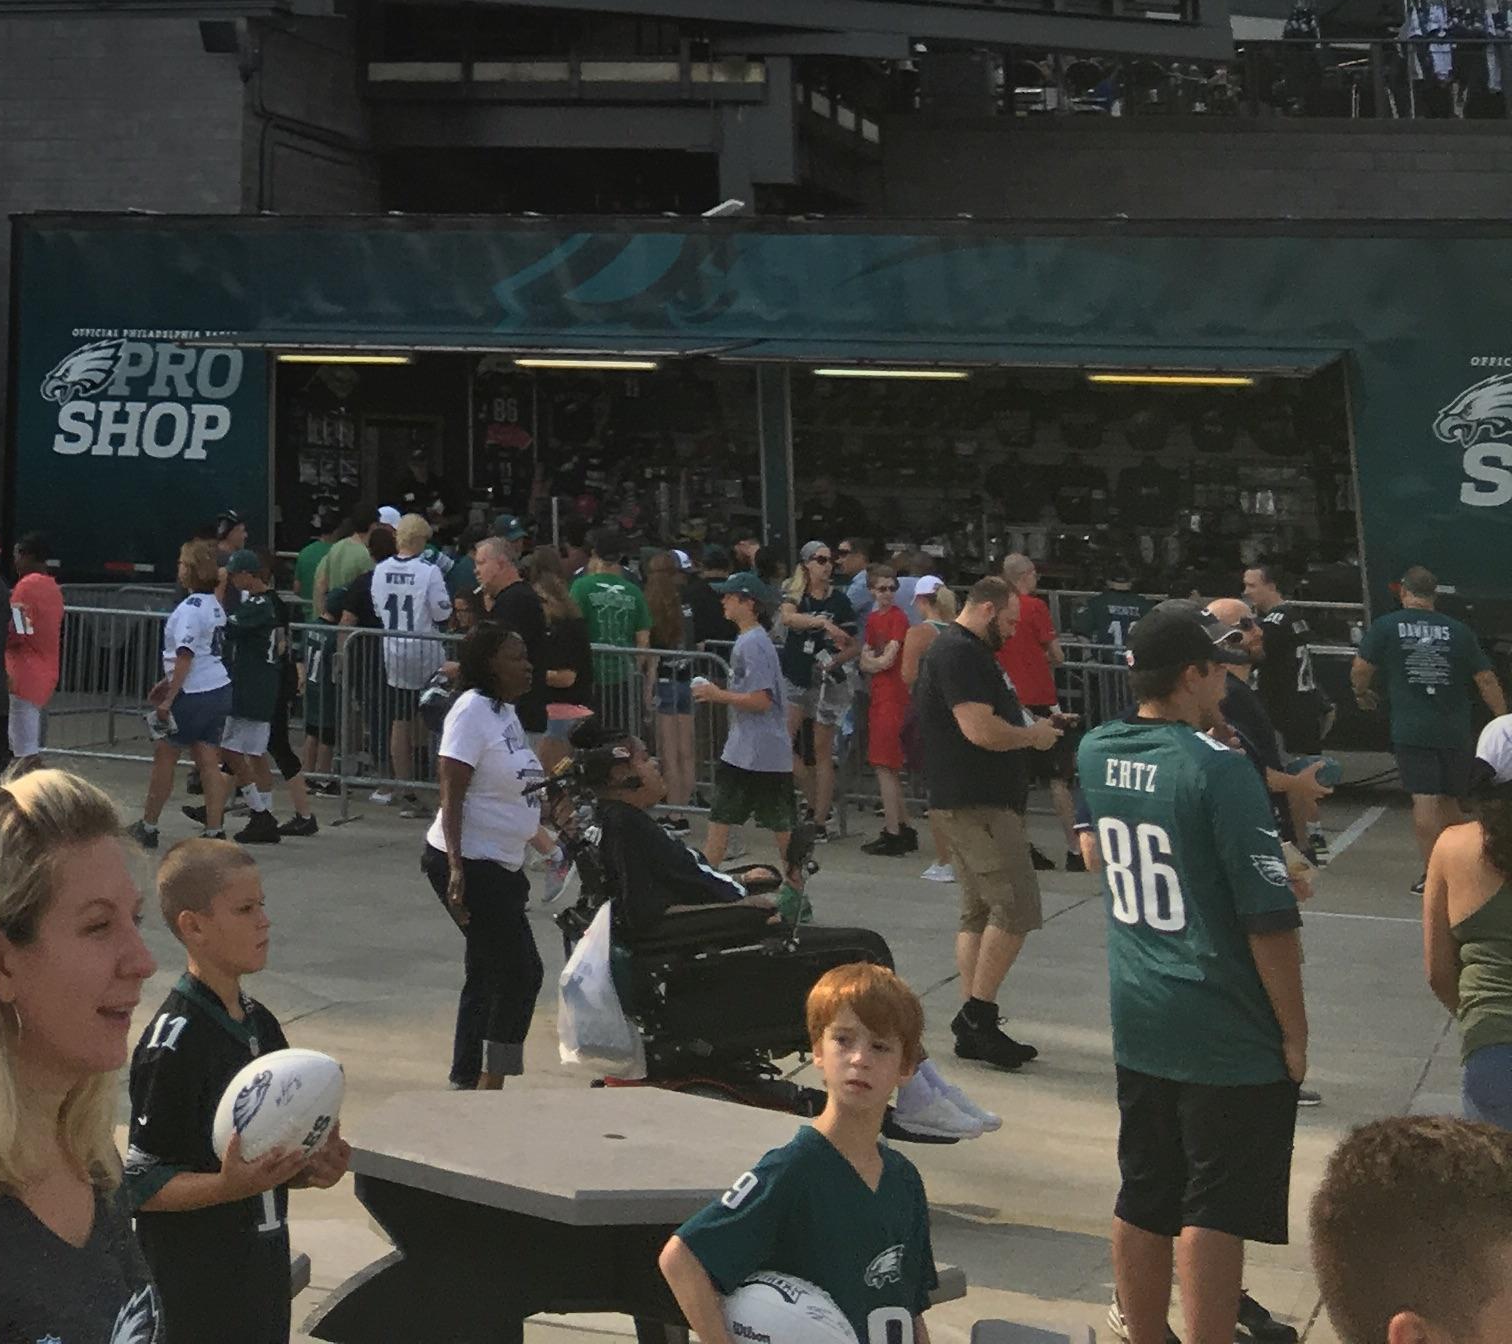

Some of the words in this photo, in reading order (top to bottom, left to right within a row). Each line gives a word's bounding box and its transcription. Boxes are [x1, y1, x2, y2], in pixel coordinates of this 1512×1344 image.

[71, 327, 119, 338] OFFICIAL
[123, 328, 201, 340] PHILADELPHIA
[106, 341, 244, 400] PRO
[1470, 356, 1512, 368] OFFIC
[52, 399, 232, 461] SHOP
[383, 592, 415, 632] 11
[1398, 622, 1450, 641] DAWKINS
[1105, 758, 1159, 793] ERTZ
[1097, 816, 1187, 932] 86
[145, 1012, 188, 1052] 11
